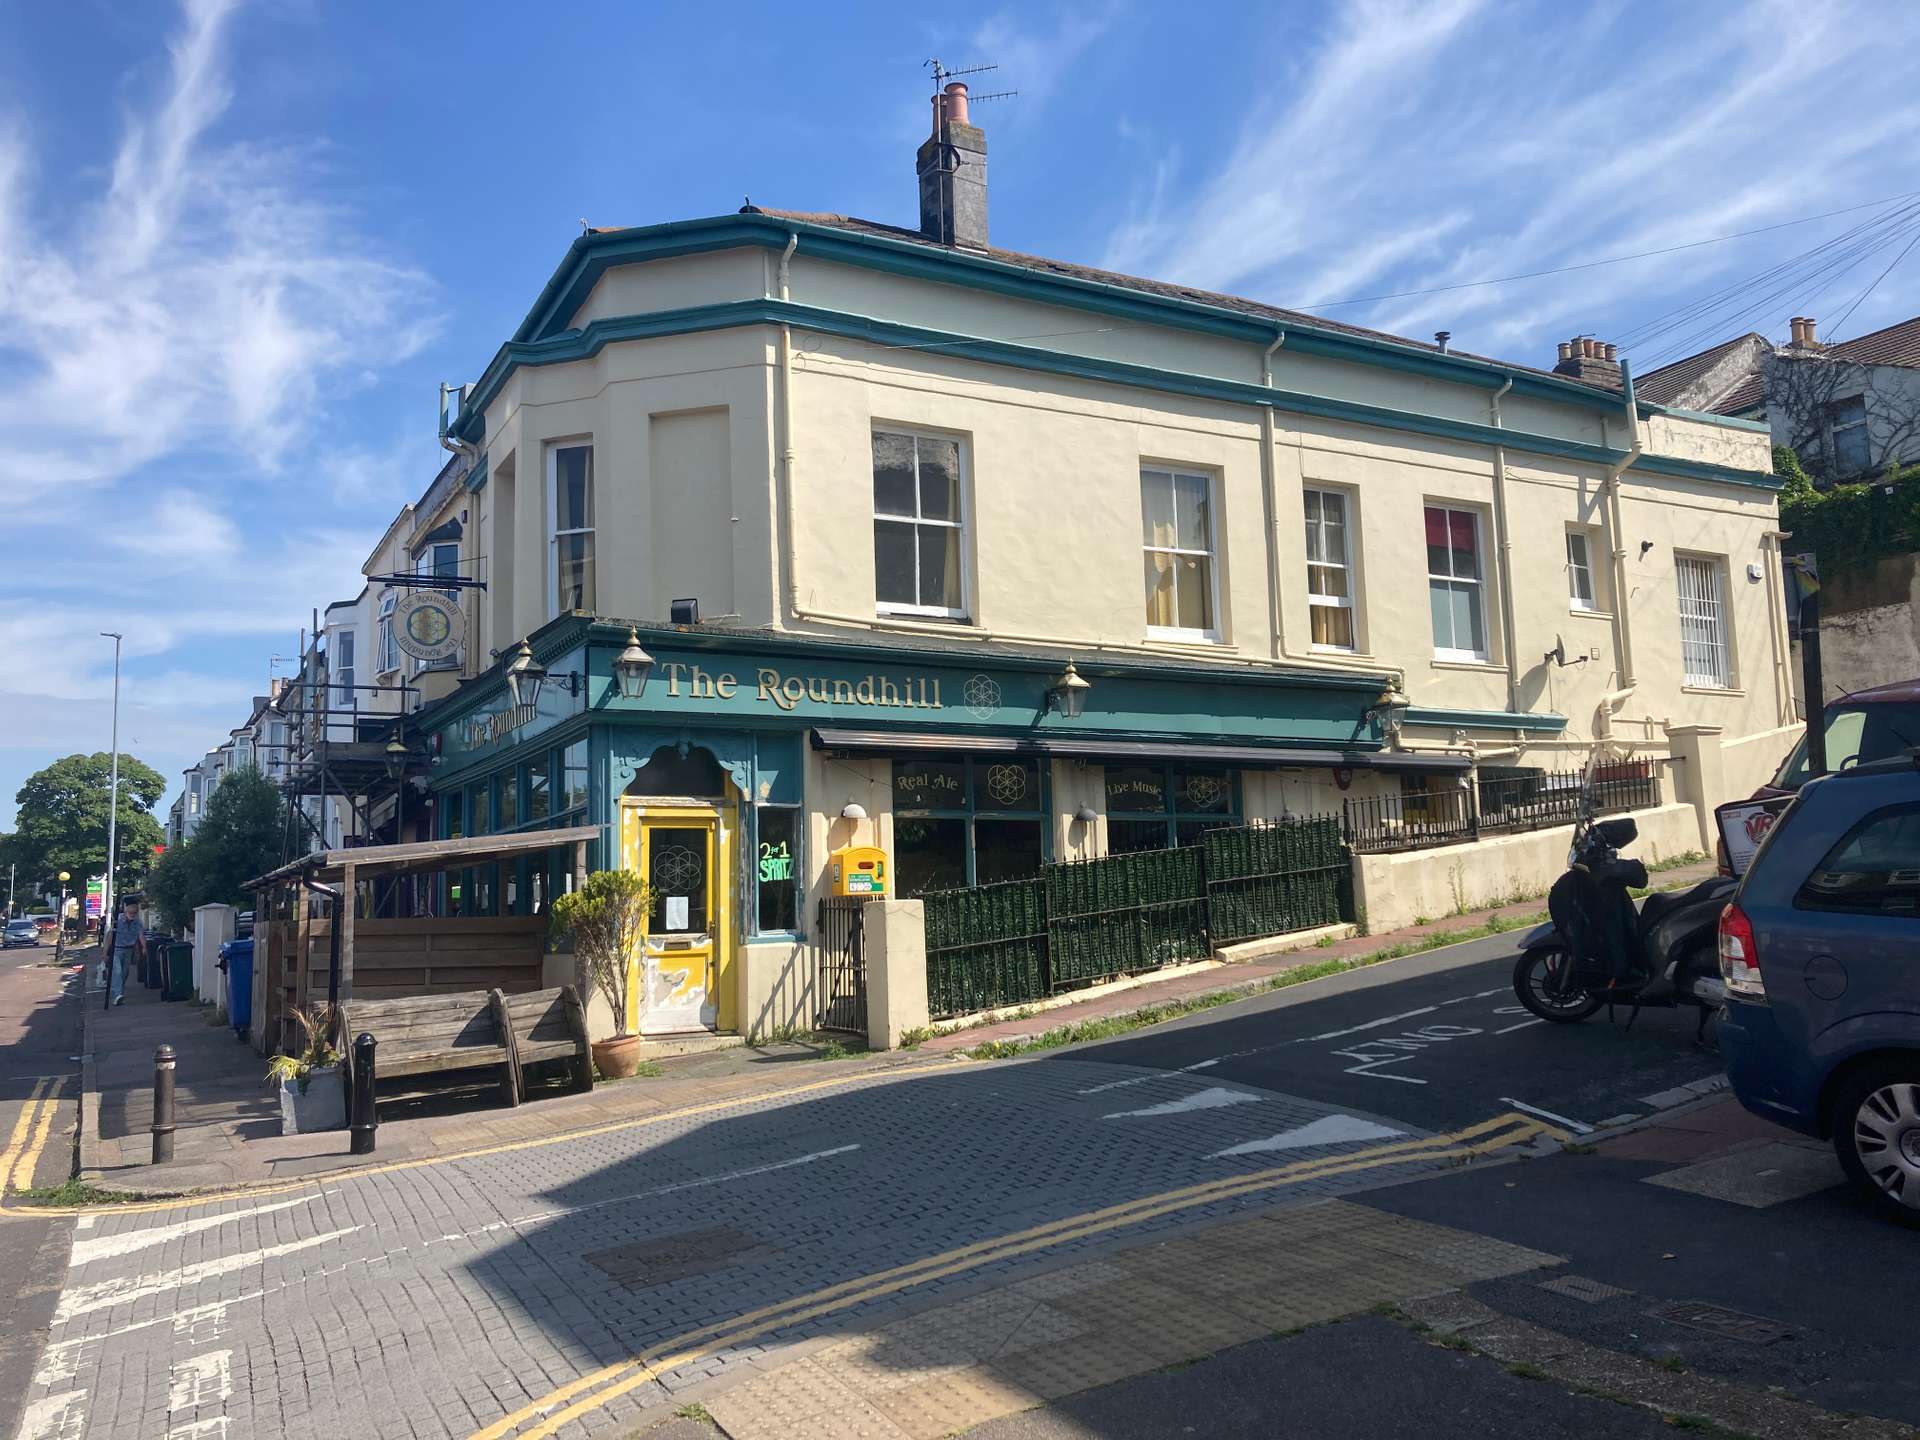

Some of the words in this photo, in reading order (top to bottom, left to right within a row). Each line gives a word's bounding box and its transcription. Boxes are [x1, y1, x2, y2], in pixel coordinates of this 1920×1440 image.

[416, 595, 458, 616] Roundhill
[661, 662, 737, 699] The
[756, 667, 943, 711] Roundhill
[470, 722, 486, 751] The
[897, 773, 928, 790] Real
[931, 774, 960, 790] Ale
[1106, 783, 1129, 796] Live
[1133, 780, 1162, 796] Music
[760, 842, 772, 859] 2
[780, 840, 790, 858] 1
[759, 858, 794, 882] SPRITZ
[1330, 1025, 1484, 1062] ONLY
